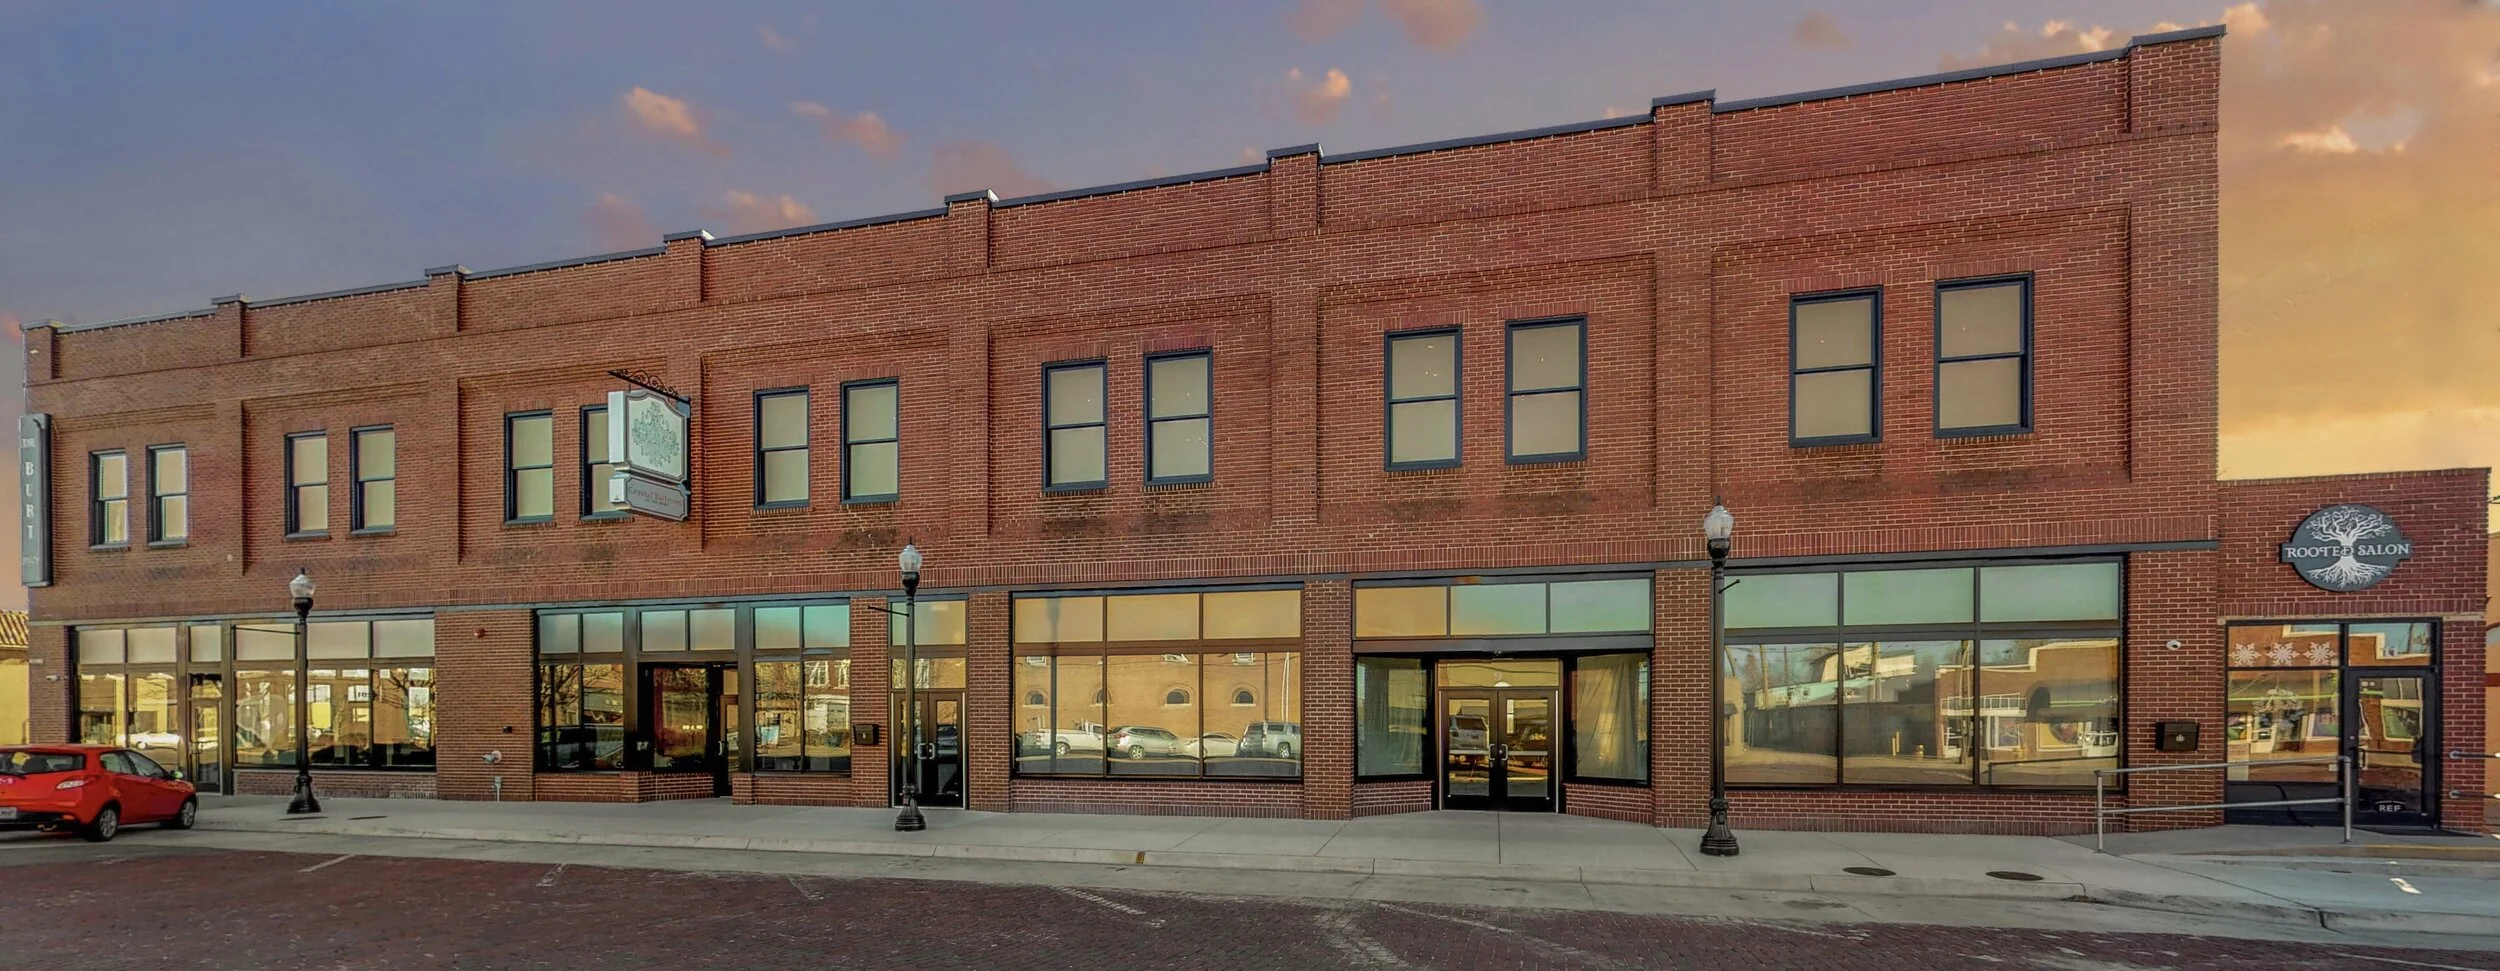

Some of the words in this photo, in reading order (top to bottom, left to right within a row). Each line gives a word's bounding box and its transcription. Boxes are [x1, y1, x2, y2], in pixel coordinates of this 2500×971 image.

[25, 461, 35, 539] BURT
[2284, 545, 2354, 558] ROOTED
[2357, 543, 2411, 556] SALON
